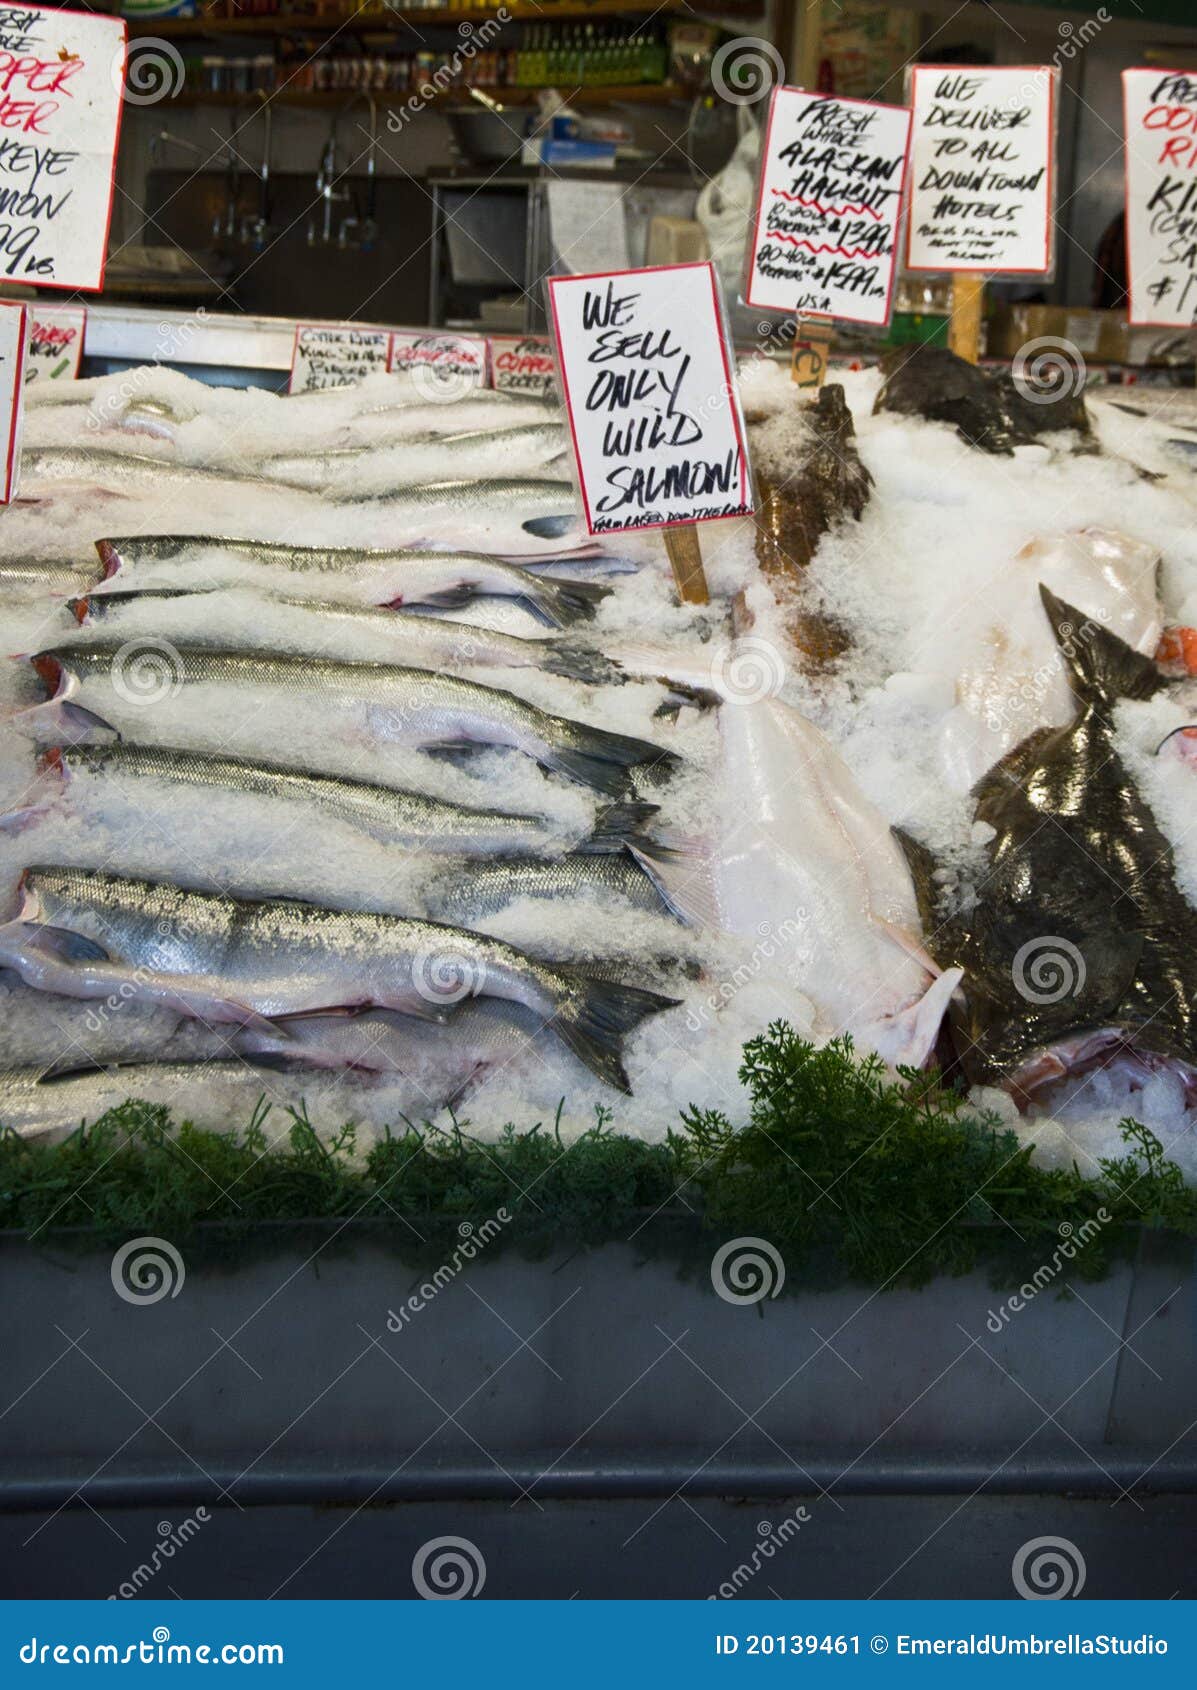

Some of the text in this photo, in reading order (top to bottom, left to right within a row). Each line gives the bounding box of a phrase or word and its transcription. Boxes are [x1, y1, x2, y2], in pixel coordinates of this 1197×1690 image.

[934, 75, 989, 101] WE
[797, 97, 880, 132] FRESH
[922, 106, 1031, 131] DELIVER
[1142, 105, 1197, 134] CO
[778, 141, 904, 181] ALASKAN
[933, 137, 1020, 162] TO ALL
[790, 170, 903, 209] HALIBUT
[932, 195, 1022, 221] HOTELS
[583, 281, 641, 330] WE
[587, 330, 681, 363] SELL
[586, 355, 691, 418] ONLY
[603, 411, 703, 457] WILD
[596, 446, 741, 512] SALMON!
